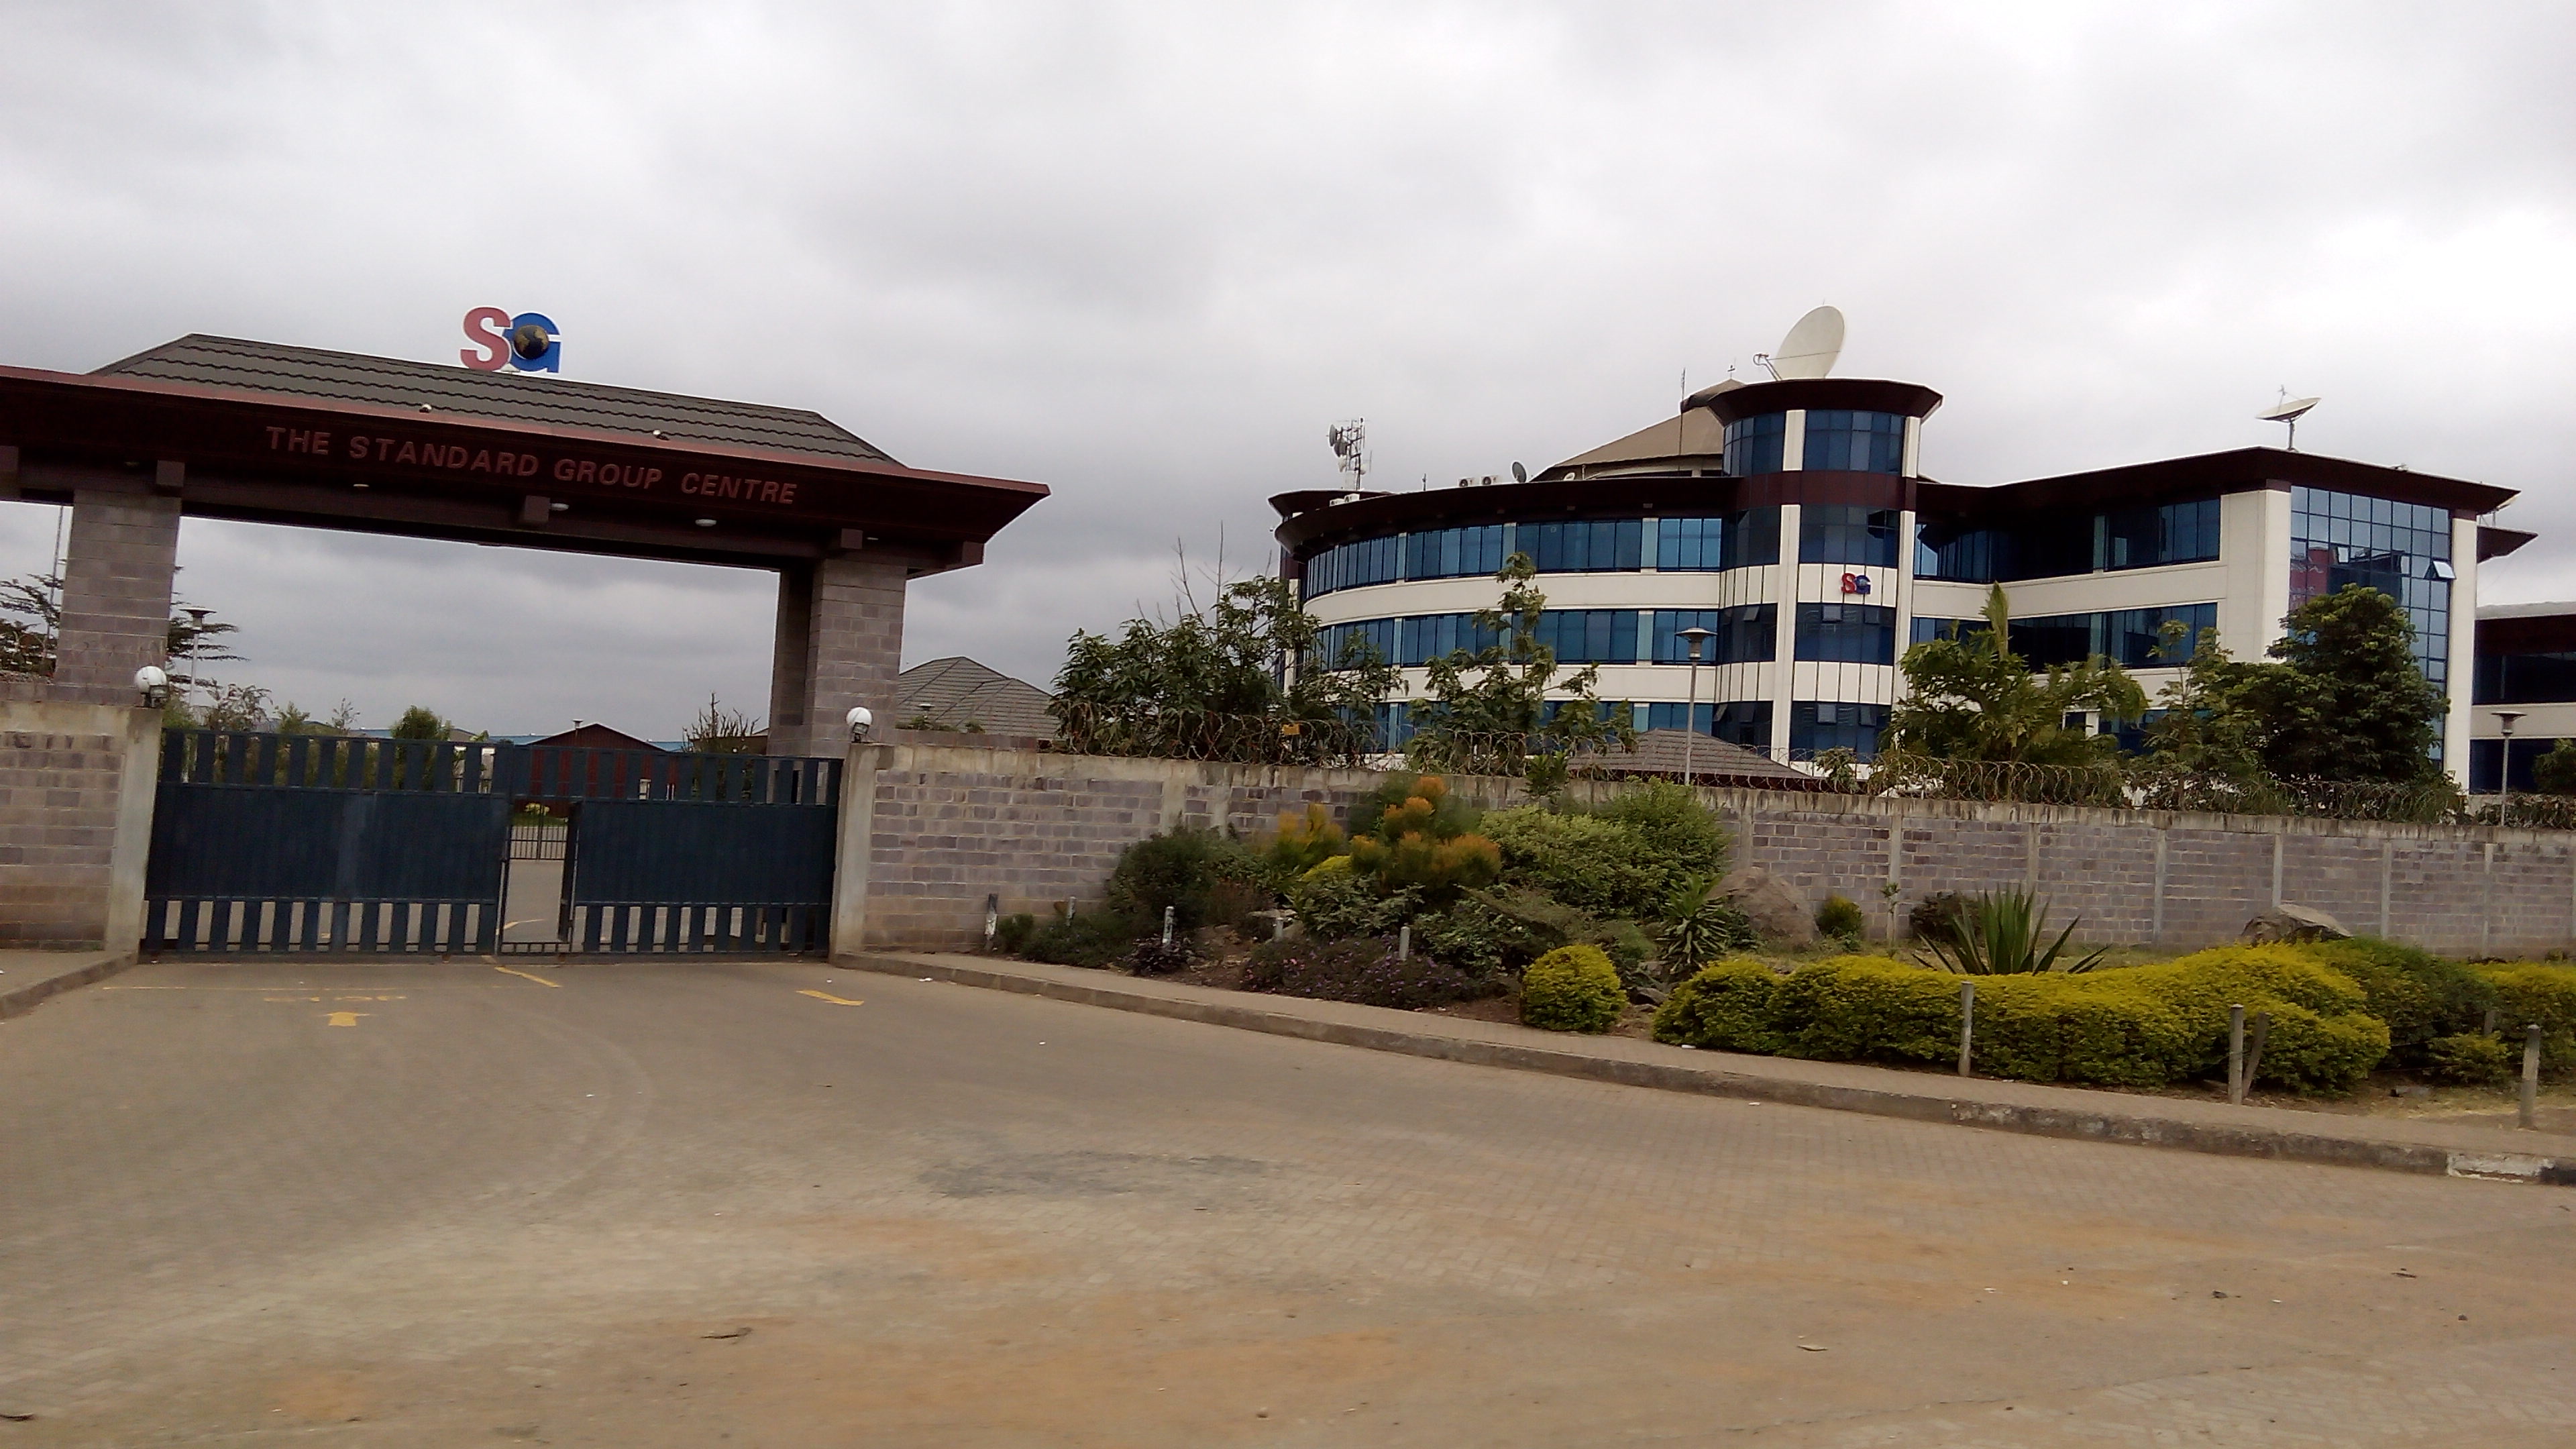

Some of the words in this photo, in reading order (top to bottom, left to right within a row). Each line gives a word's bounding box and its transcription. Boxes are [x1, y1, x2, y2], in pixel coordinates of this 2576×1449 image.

[266, 426, 331, 455] THE
[349, 436, 539, 476] STANDARD
[554, 458, 662, 489] GROUP
[681, 473, 798, 504] CENTRE
